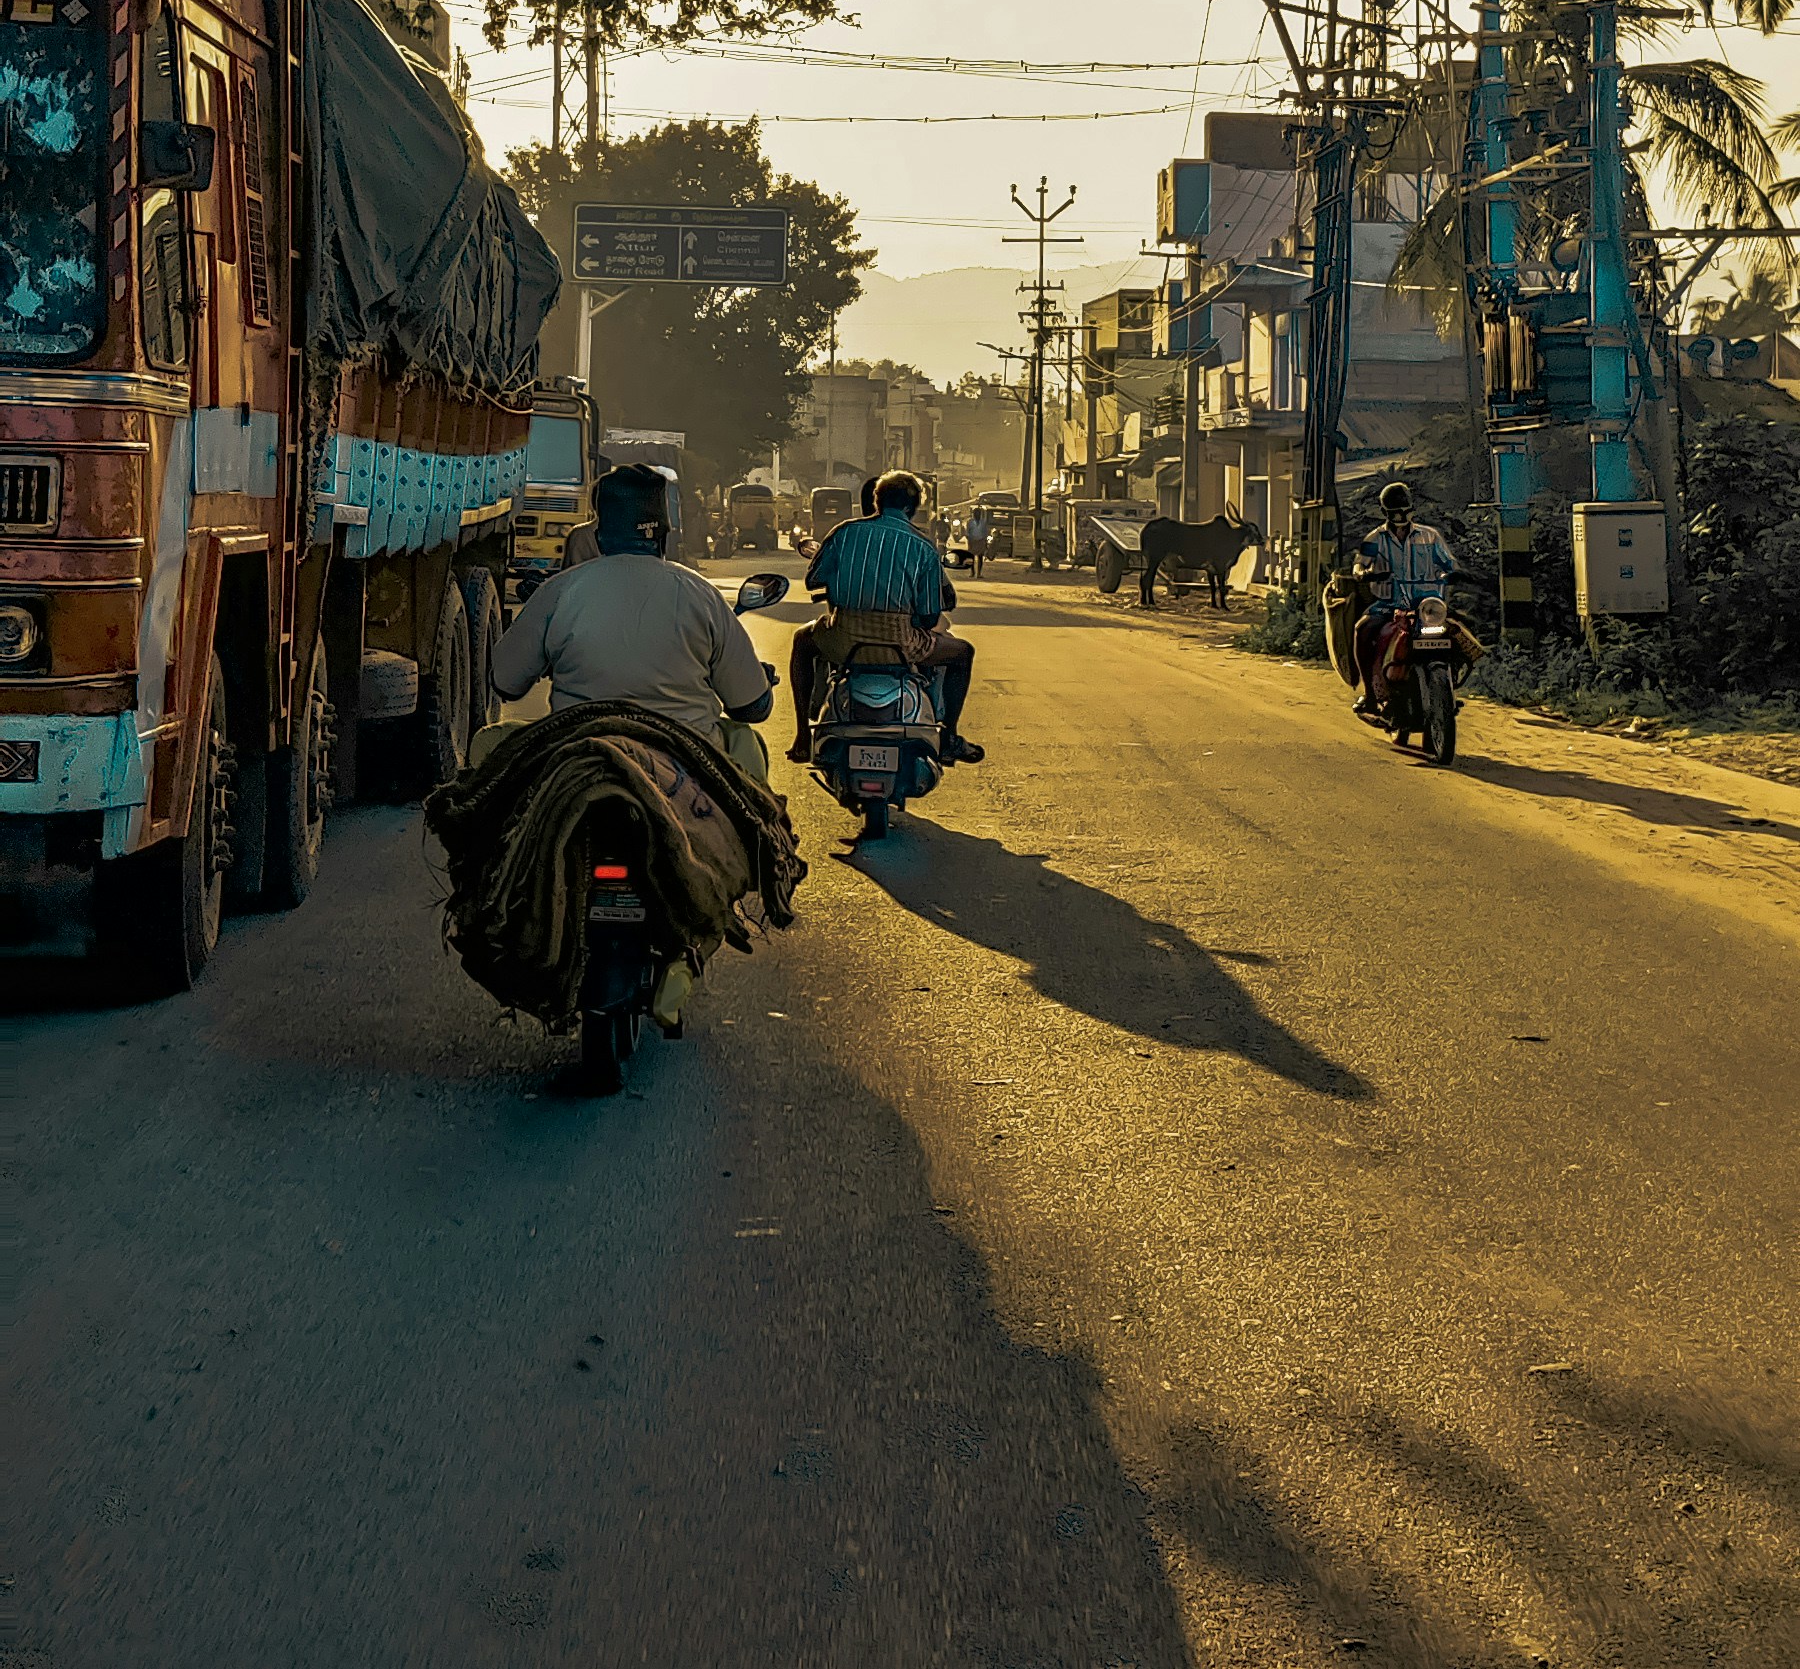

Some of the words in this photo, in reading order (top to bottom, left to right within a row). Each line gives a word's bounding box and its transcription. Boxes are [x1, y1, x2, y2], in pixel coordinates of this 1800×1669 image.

[615, 243, 657, 252] Attur
[717, 246, 760, 254] Chennai
[605, 266, 632, 274] Four
[635, 267, 665, 276] Road
